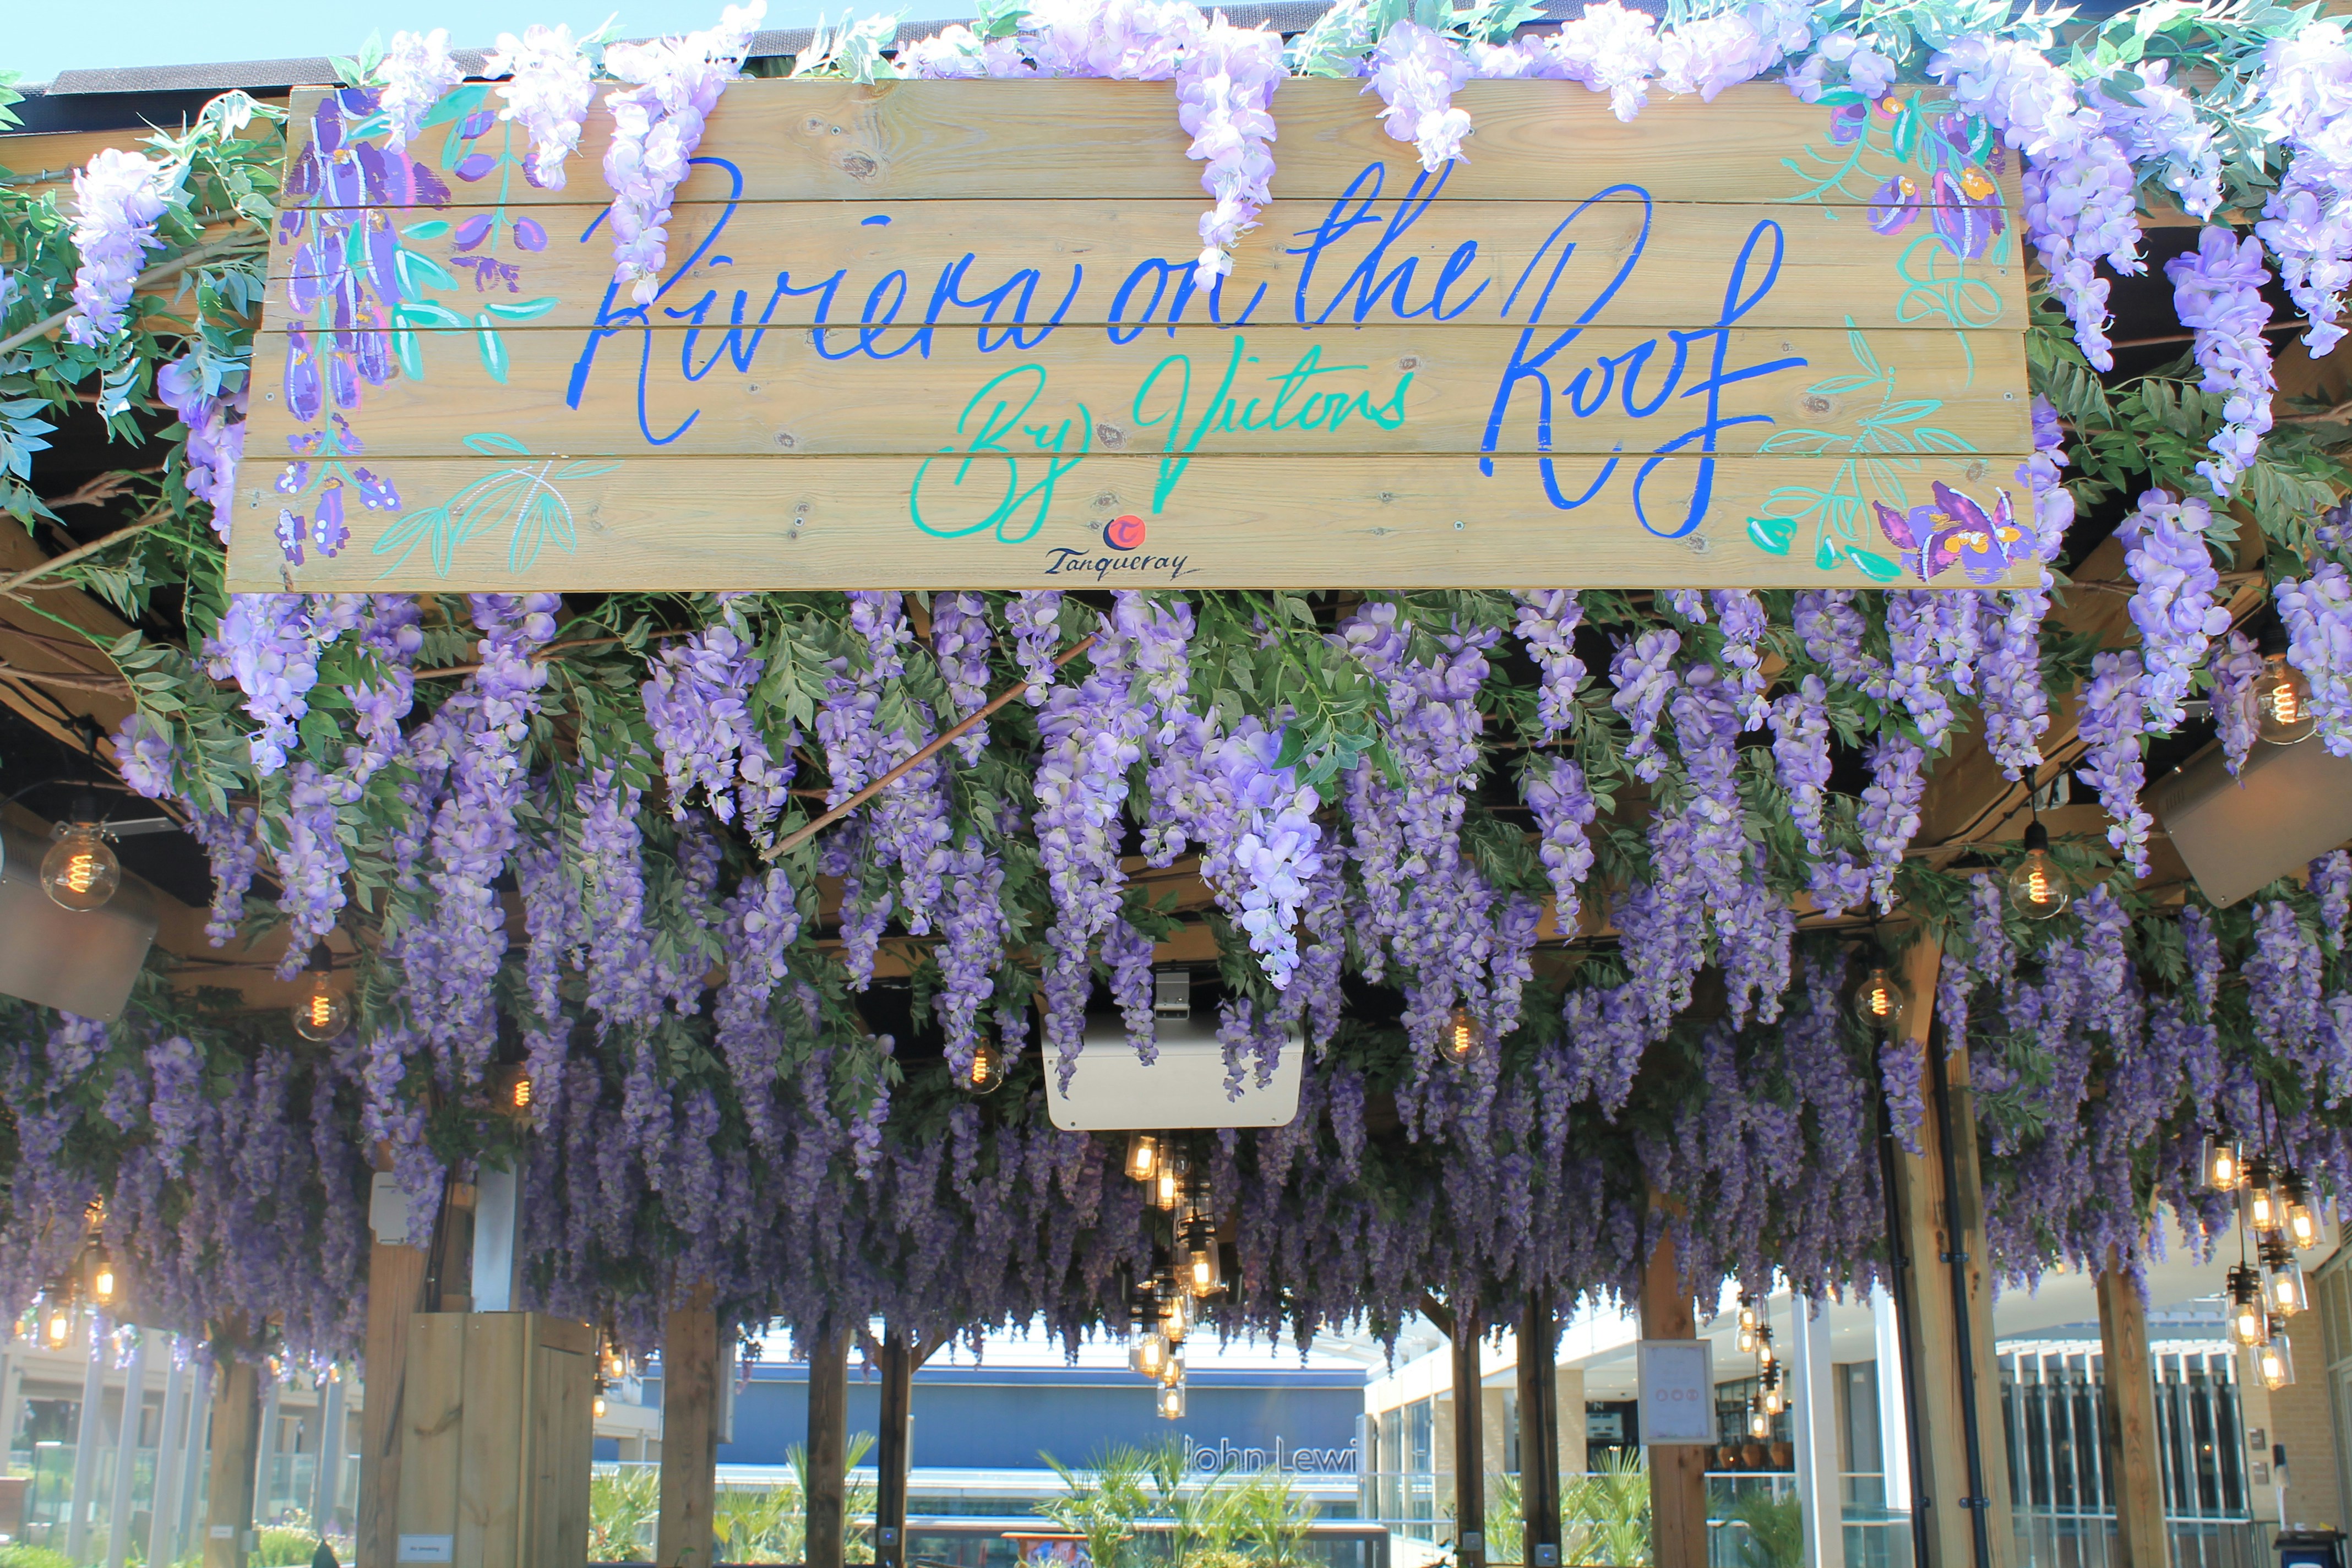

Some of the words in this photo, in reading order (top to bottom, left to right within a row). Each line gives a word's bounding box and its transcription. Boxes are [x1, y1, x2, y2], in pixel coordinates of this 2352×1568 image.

[565, 157, 1082, 445] Riviera
[1107, 251, 1267, 345] on
[1285, 161, 1491, 330] the
[1479, 183, 1809, 538] Roof
[911, 364, 1091, 543] By
[1044, 547, 1201, 582] Tanqueray
[1184, 1433, 1266, 1473] John
[1276, 1434, 1358, 1473] Lewi
